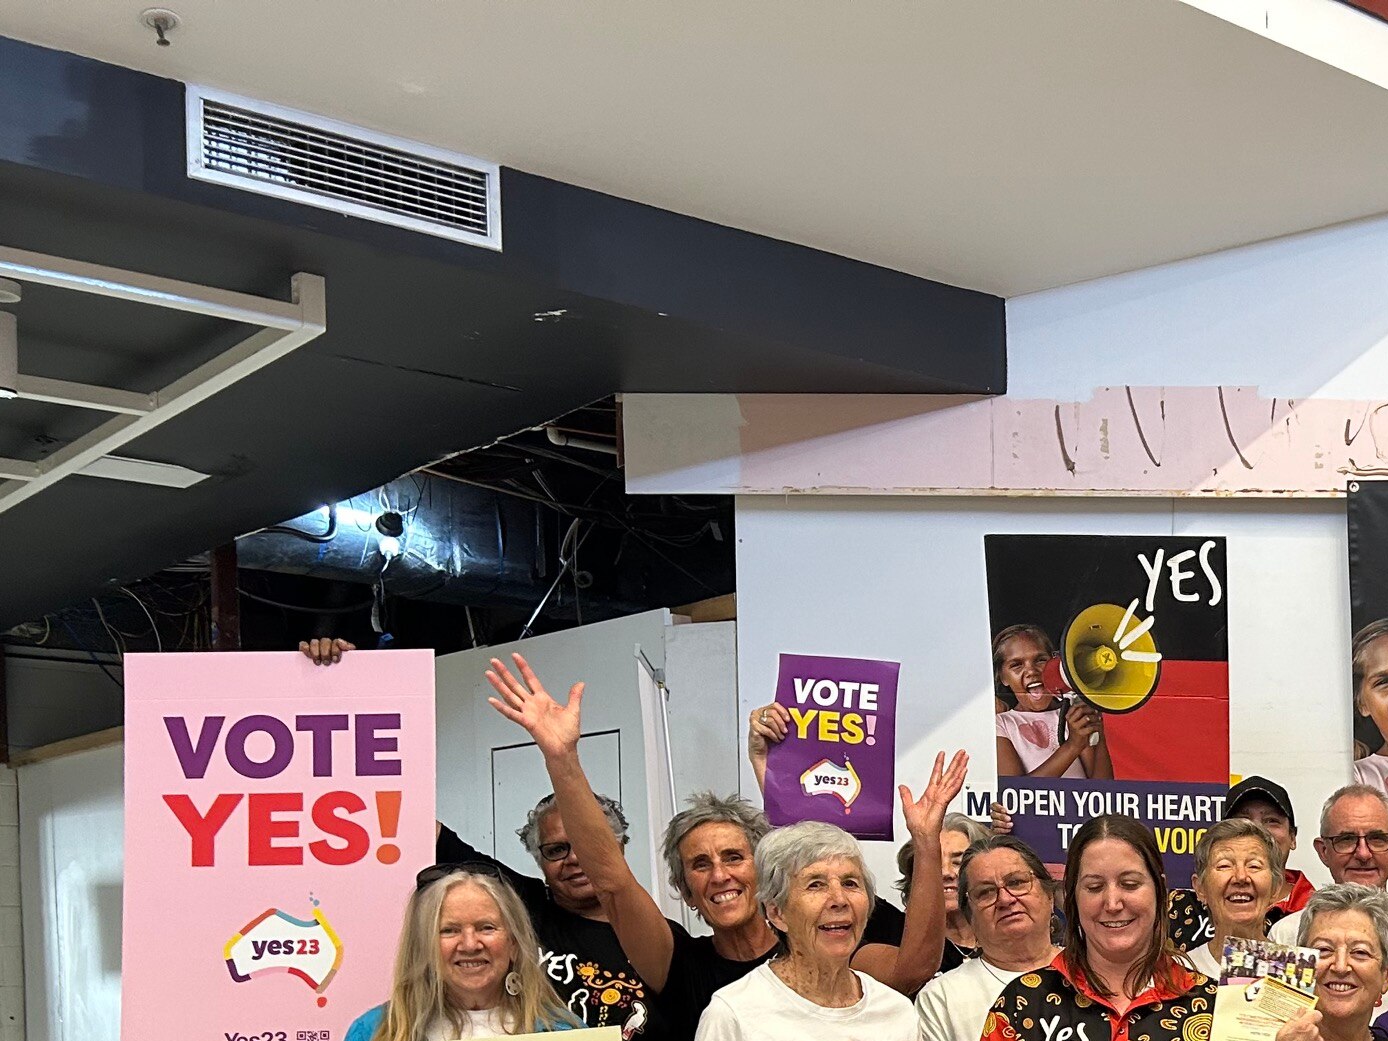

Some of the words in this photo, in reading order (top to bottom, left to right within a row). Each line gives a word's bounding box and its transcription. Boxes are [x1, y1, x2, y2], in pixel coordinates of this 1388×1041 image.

[1138, 540, 1223, 611] YES
[793, 677, 879, 711] VOTE
[788, 707, 877, 746] YES!
[163, 712, 402, 779] VOTE
[1002, 788, 1065, 817] OPEN
[1076, 790, 1140, 819] YOUR
[1147, 793, 1226, 822] HEART
[162, 790, 403, 868] YES!
[1191, 915, 1216, 942] Ye
[251, 936, 320, 962] yes23
